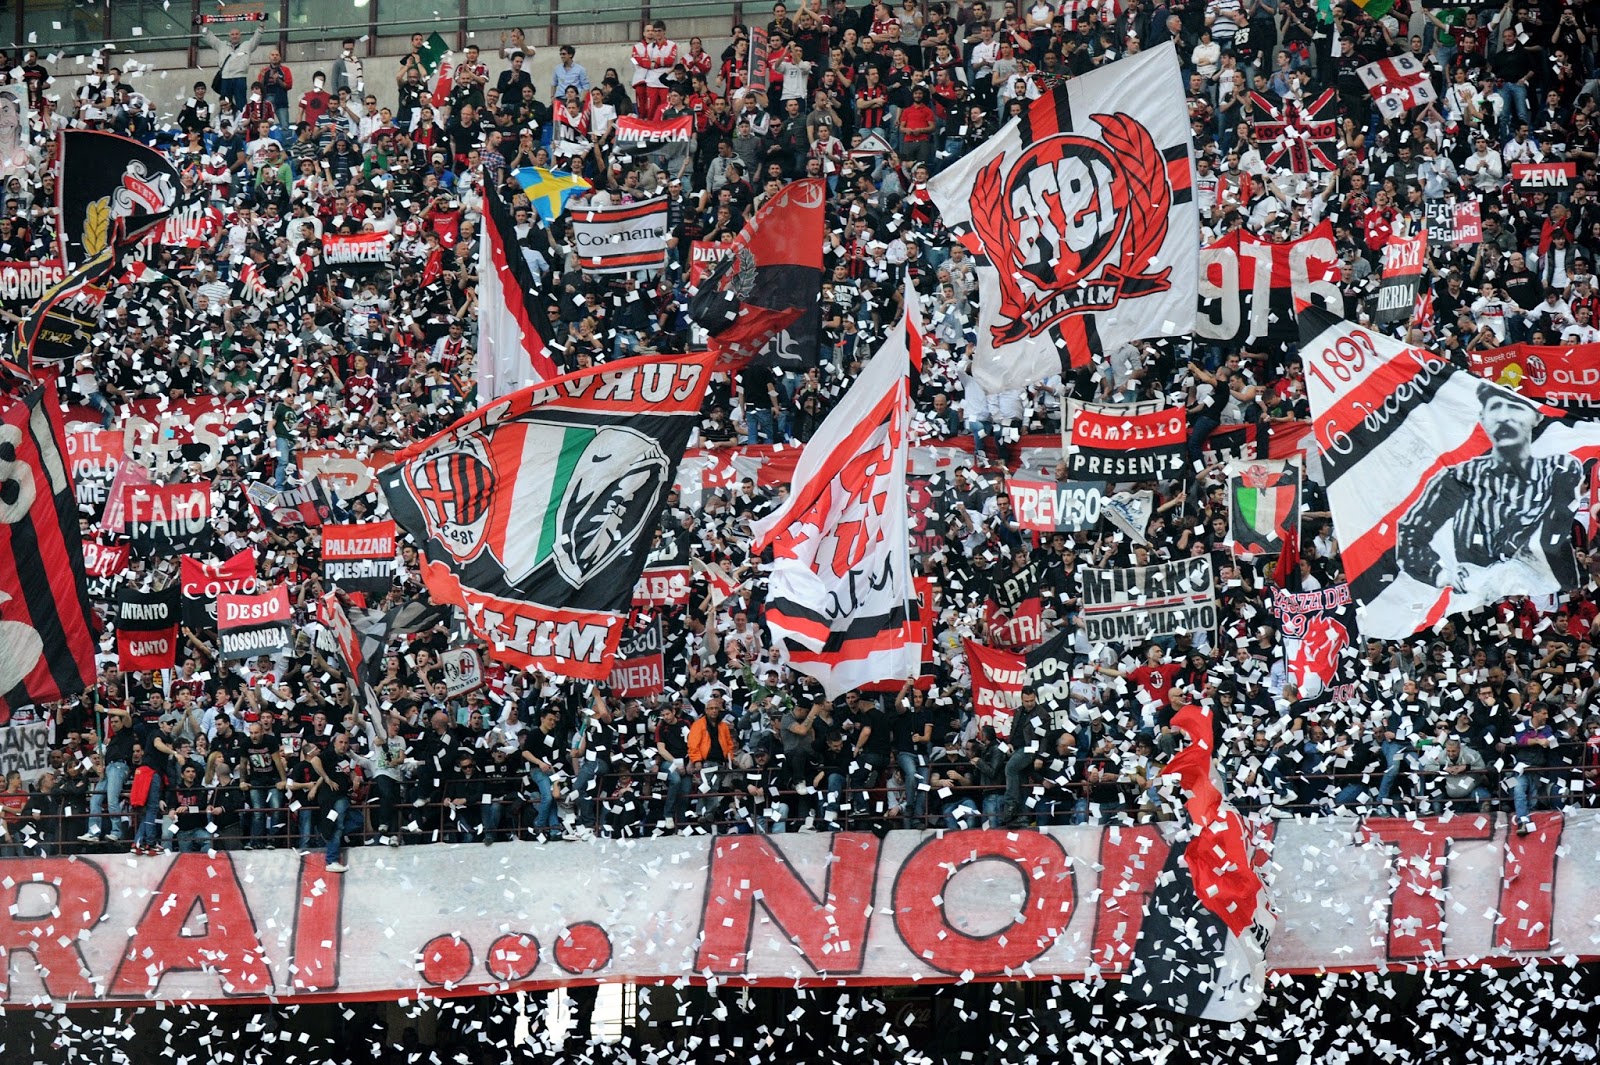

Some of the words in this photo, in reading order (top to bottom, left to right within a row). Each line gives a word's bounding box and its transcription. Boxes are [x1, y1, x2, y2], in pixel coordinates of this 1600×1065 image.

[617, 127, 689, 143] IMPERIA
[1520, 168, 1568, 188] ZENA
[1428, 201, 1477, 218] SEMPRE
[323, 240, 391, 265] CAVARZERE
[1553, 368, 1600, 385] OLD
[1009, 485, 1100, 528] TREVISO
[325, 537, 391, 555] PALAZZARI
[325, 561, 391, 579] PRESENTI
[1083, 557, 1211, 605] MILANO
[183, 575, 257, 600] COVO
[121, 602, 168, 620] INTANTO
[226, 597, 280, 621] DESIO
[1086, 605, 1215, 642] DOMNIAMO
[129, 638, 168, 657] CANTO
[222, 626, 289, 654] ROSSONERA
[0, 726, 48, 753] ANO
[0, 750, 46, 773] TALE
